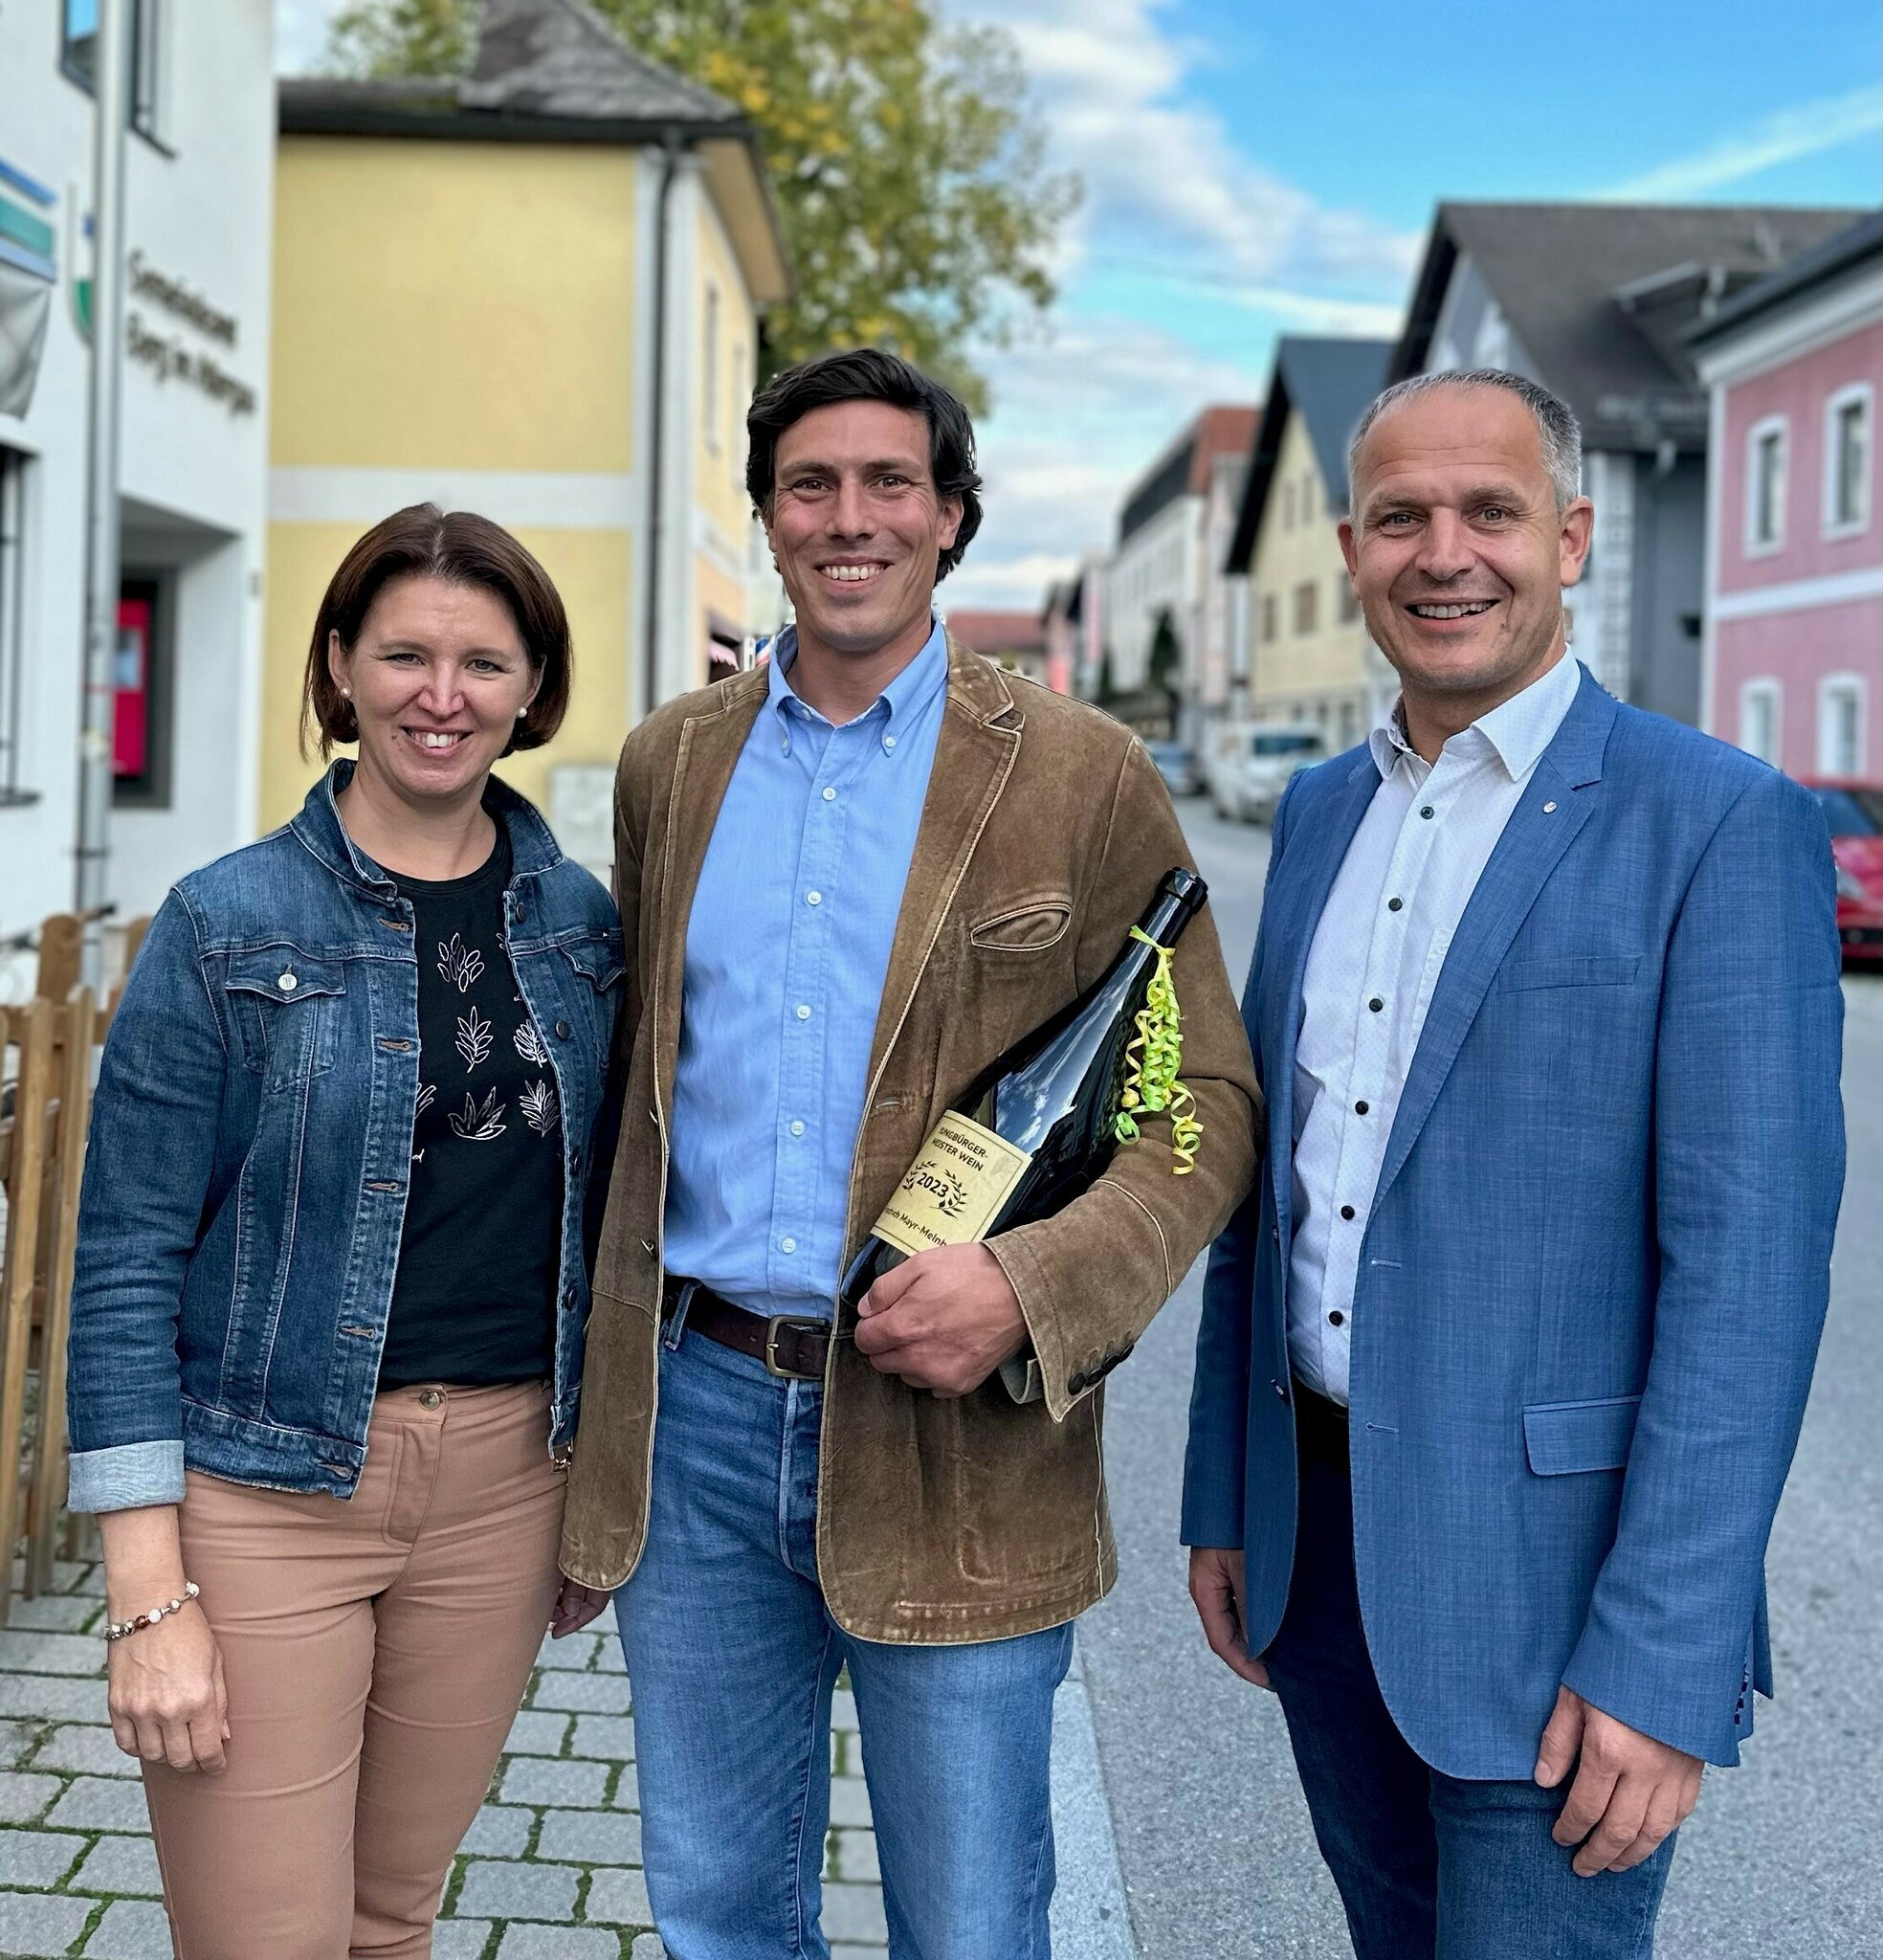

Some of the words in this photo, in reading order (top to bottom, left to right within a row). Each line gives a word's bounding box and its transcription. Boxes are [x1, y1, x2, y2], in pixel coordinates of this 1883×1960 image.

[958, 1150, 985, 1172] WEIN
[917, 1171, 949, 1198] 2023
[899, 1213, 947, 1247] Mayr-Melnh
